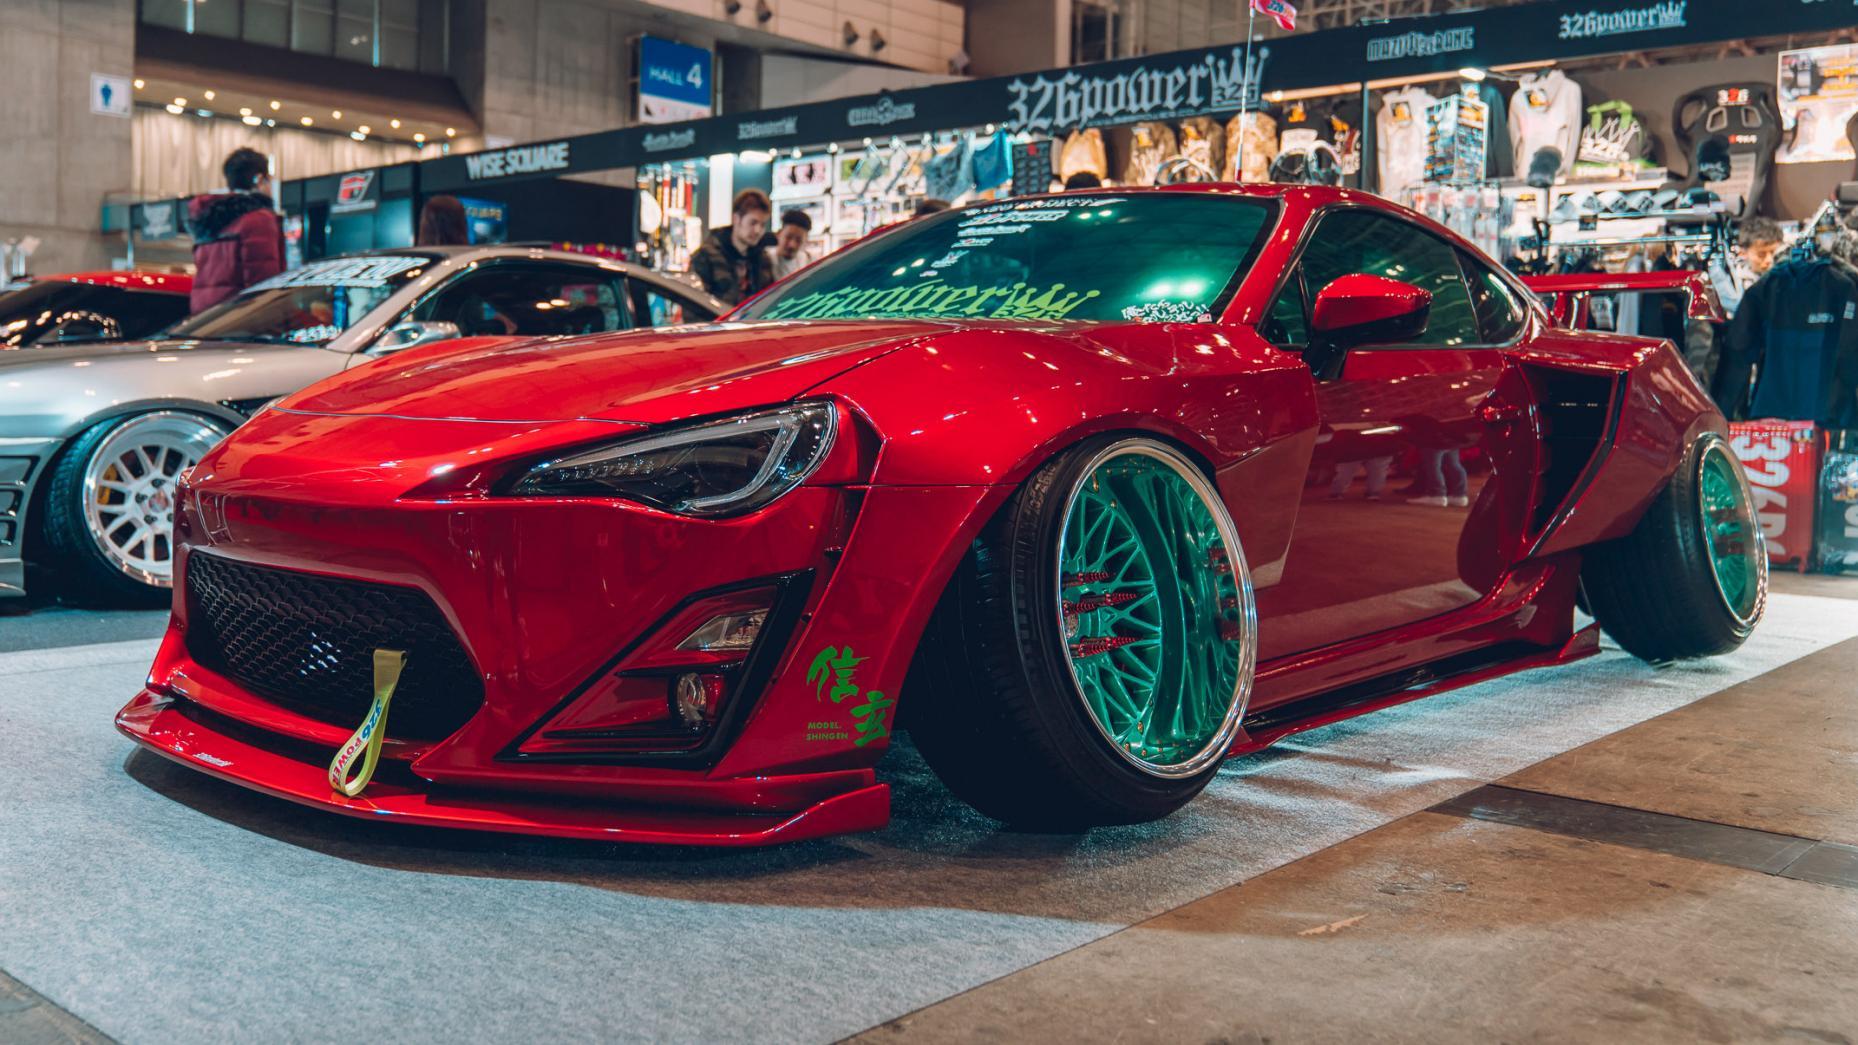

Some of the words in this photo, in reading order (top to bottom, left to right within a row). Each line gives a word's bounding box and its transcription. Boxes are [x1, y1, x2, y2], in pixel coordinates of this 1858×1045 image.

[686, 62, 703, 89] 4
[1007, 64, 1209, 132] 326power
[465, 151, 505, 180] WISE
[505, 142, 569, 175] SQUARE
[361, 697, 383, 740] 326
[806, 732, 849, 741] SHINGEN
